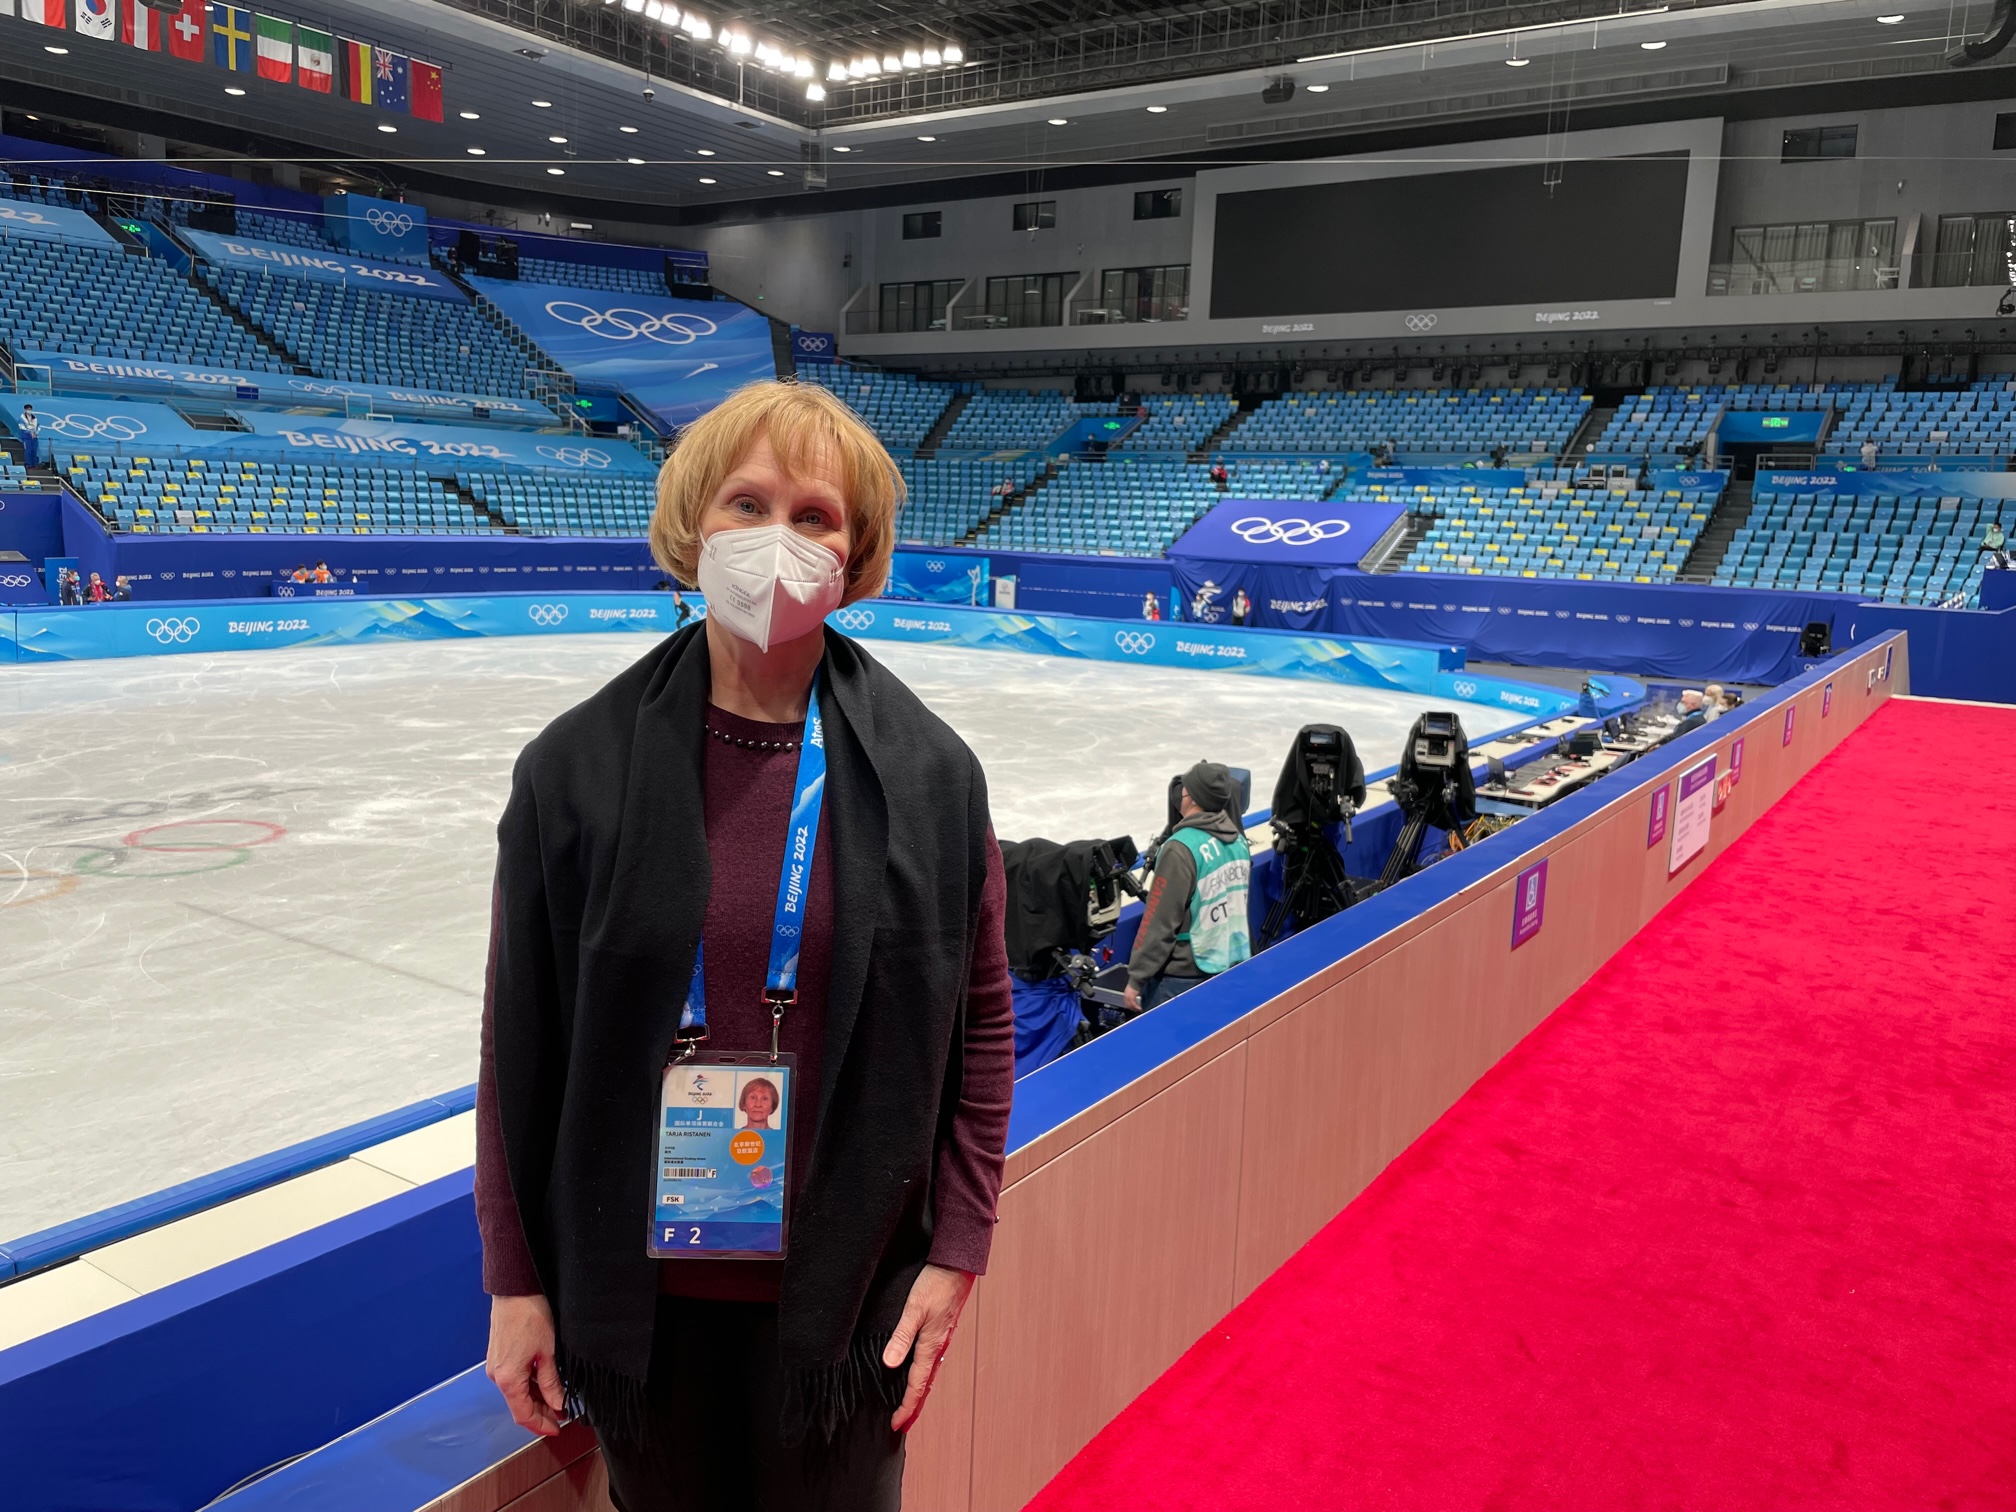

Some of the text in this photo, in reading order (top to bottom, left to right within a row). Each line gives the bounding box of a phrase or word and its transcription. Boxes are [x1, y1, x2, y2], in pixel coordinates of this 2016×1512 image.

[220, 242, 442, 288] BEIJING 2022
[1535, 311, 1600, 324] BEIJING 2022
[1262, 323, 1315, 334] BEIJING 2022
[61, 359, 259, 386] BEIJING 2022
[277, 430, 518, 458] BEIJING 2022
[1771, 476, 1838, 487] BEIJING 2022
[589, 608, 658, 621] BEIJING 2022
[228, 619, 310, 636] BEIJING 2022
[894, 618, 952, 632] BEIJING 2022
[1176, 641, 1248, 658] BEIJING 2022
[1500, 690, 1540, 708] BEIJING 2022
[784, 825, 809, 913] BEIJING 2022
[1210, 902, 1228, 923] CT
[696, 1110, 703, 1121] J
[664, 1227, 701, 1244] F 2
